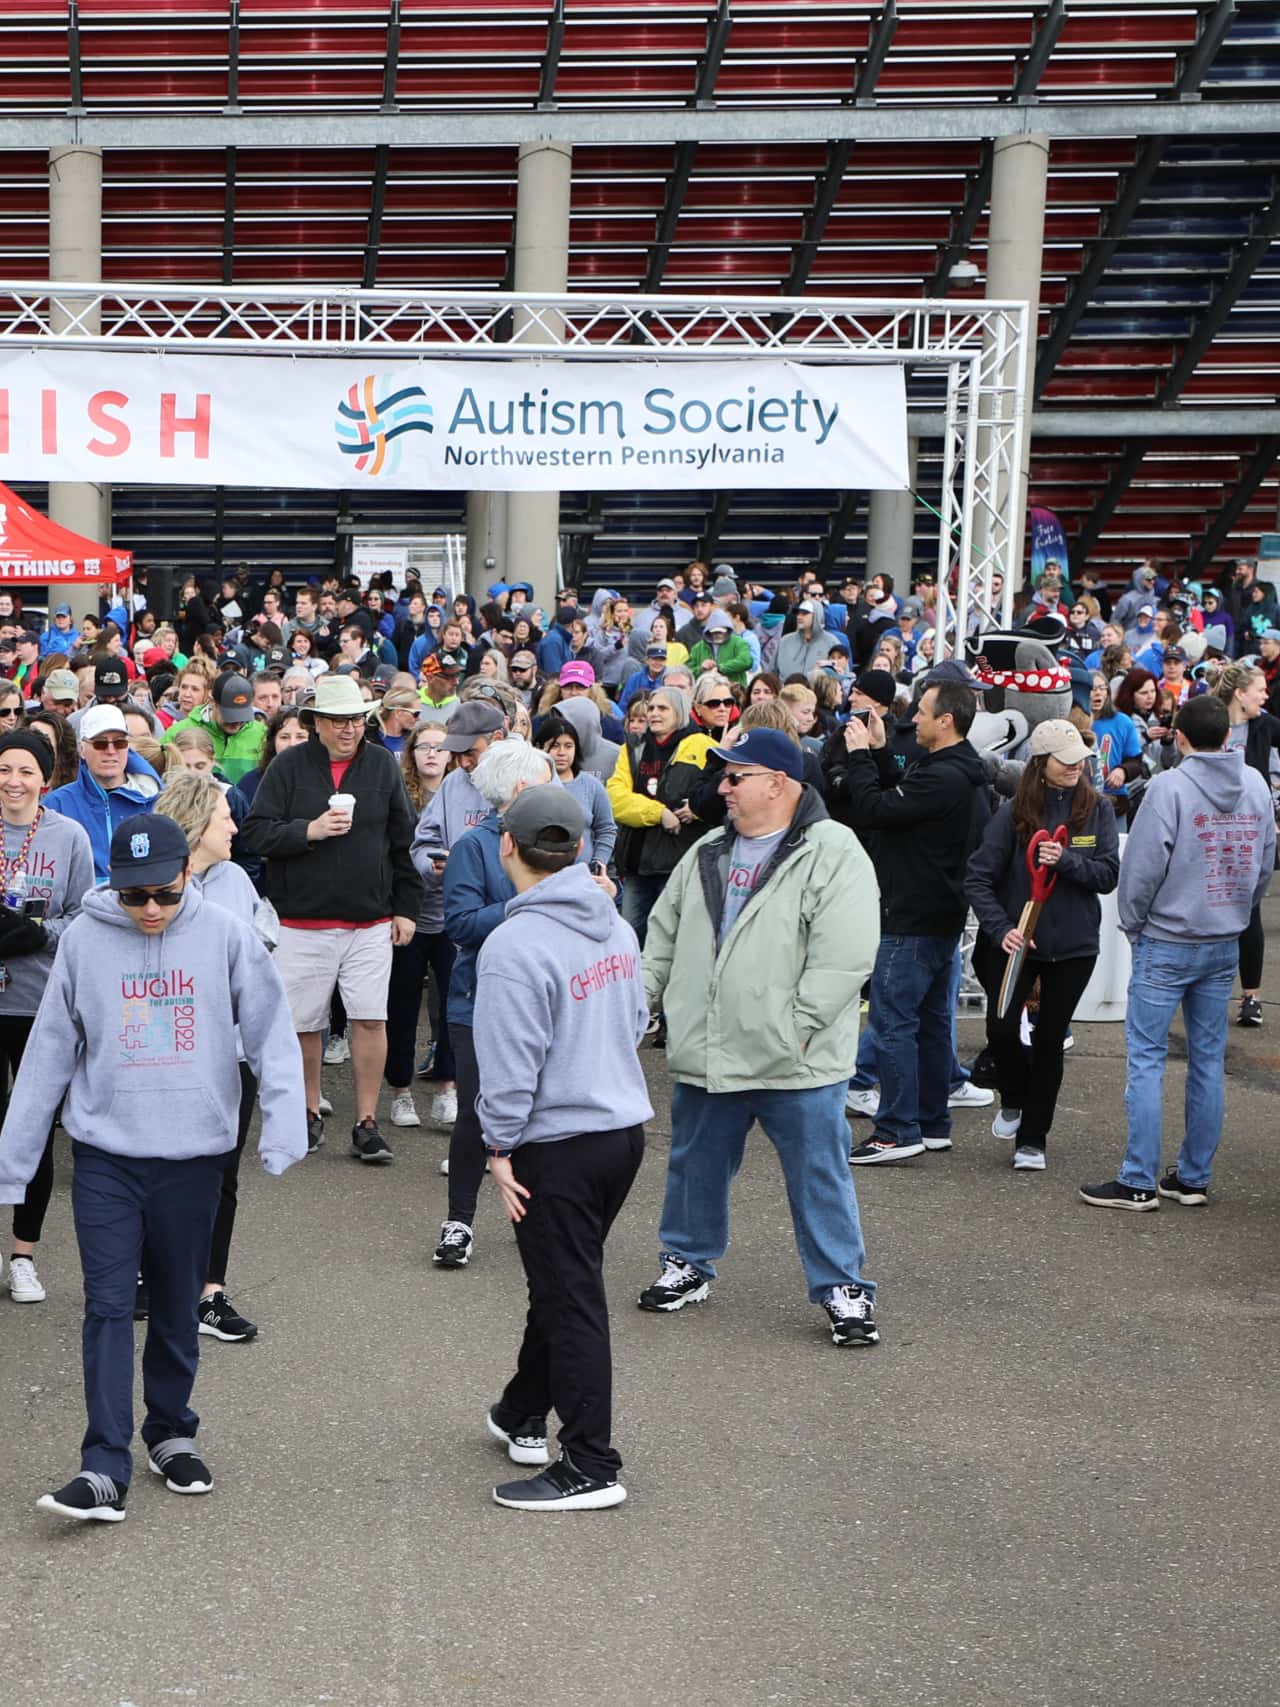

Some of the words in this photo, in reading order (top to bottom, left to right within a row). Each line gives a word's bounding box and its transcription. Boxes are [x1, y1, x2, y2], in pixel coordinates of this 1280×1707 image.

[448, 387, 626, 439] Autism
[643, 385, 839, 445] Society
[444, 445, 613, 466] Northwestern
[621, 442, 785, 470] Pennsylvania
[121, 969, 195, 999] walk
[173, 1005, 195, 1052] 2022
